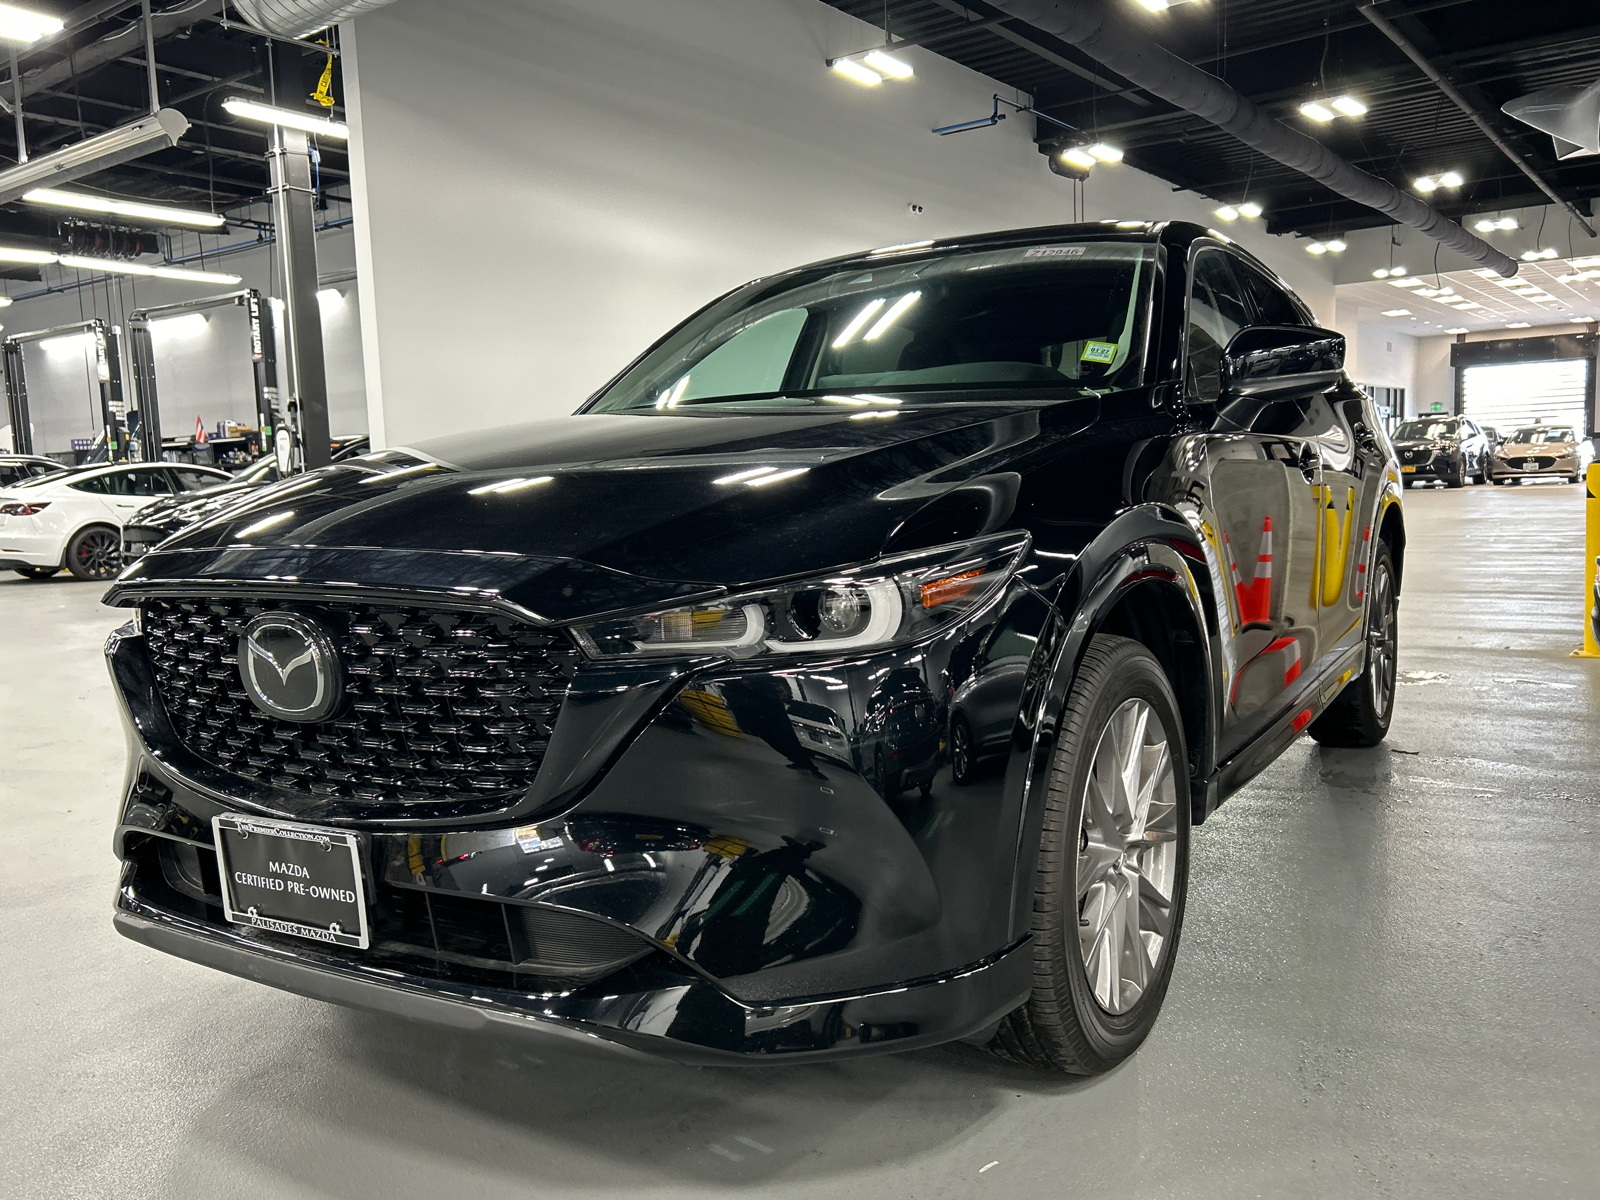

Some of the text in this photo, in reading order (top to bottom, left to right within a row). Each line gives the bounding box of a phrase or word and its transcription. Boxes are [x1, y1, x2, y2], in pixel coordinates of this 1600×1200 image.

[249, 297, 262, 354] ROTARY LIFT
[269, 861, 310, 879] MAZDA
[234, 871, 356, 903] CERTIFIED PRE-OWNED
[251, 918, 336, 942] PALISADES MAZDA
